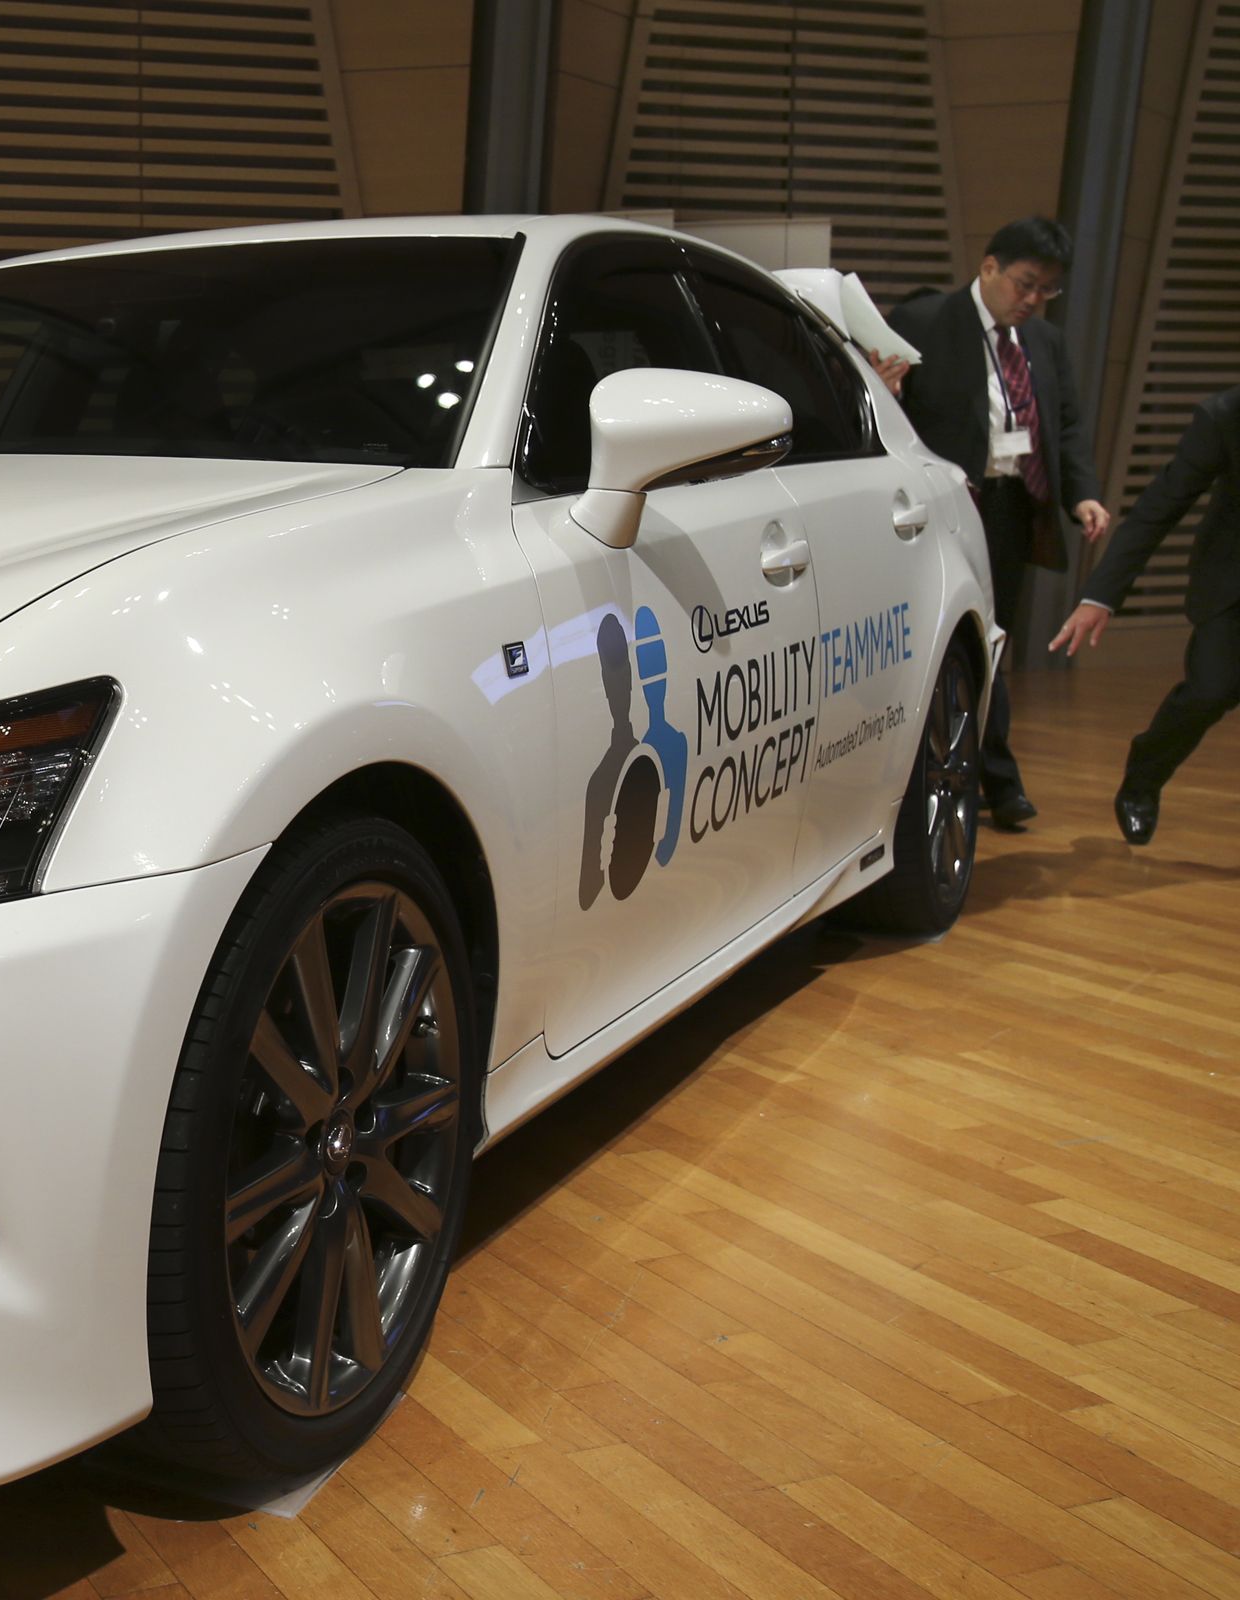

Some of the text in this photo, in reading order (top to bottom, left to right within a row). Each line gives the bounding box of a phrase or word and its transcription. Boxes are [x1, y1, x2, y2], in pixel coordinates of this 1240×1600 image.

[714, 600, 770, 638] LEXUS
[696, 602, 912, 756] MOBILITY TEAMMATE
[690, 716, 815, 844] CONCEPT
[814, 701, 906, 772] Automated Driving Tech.
